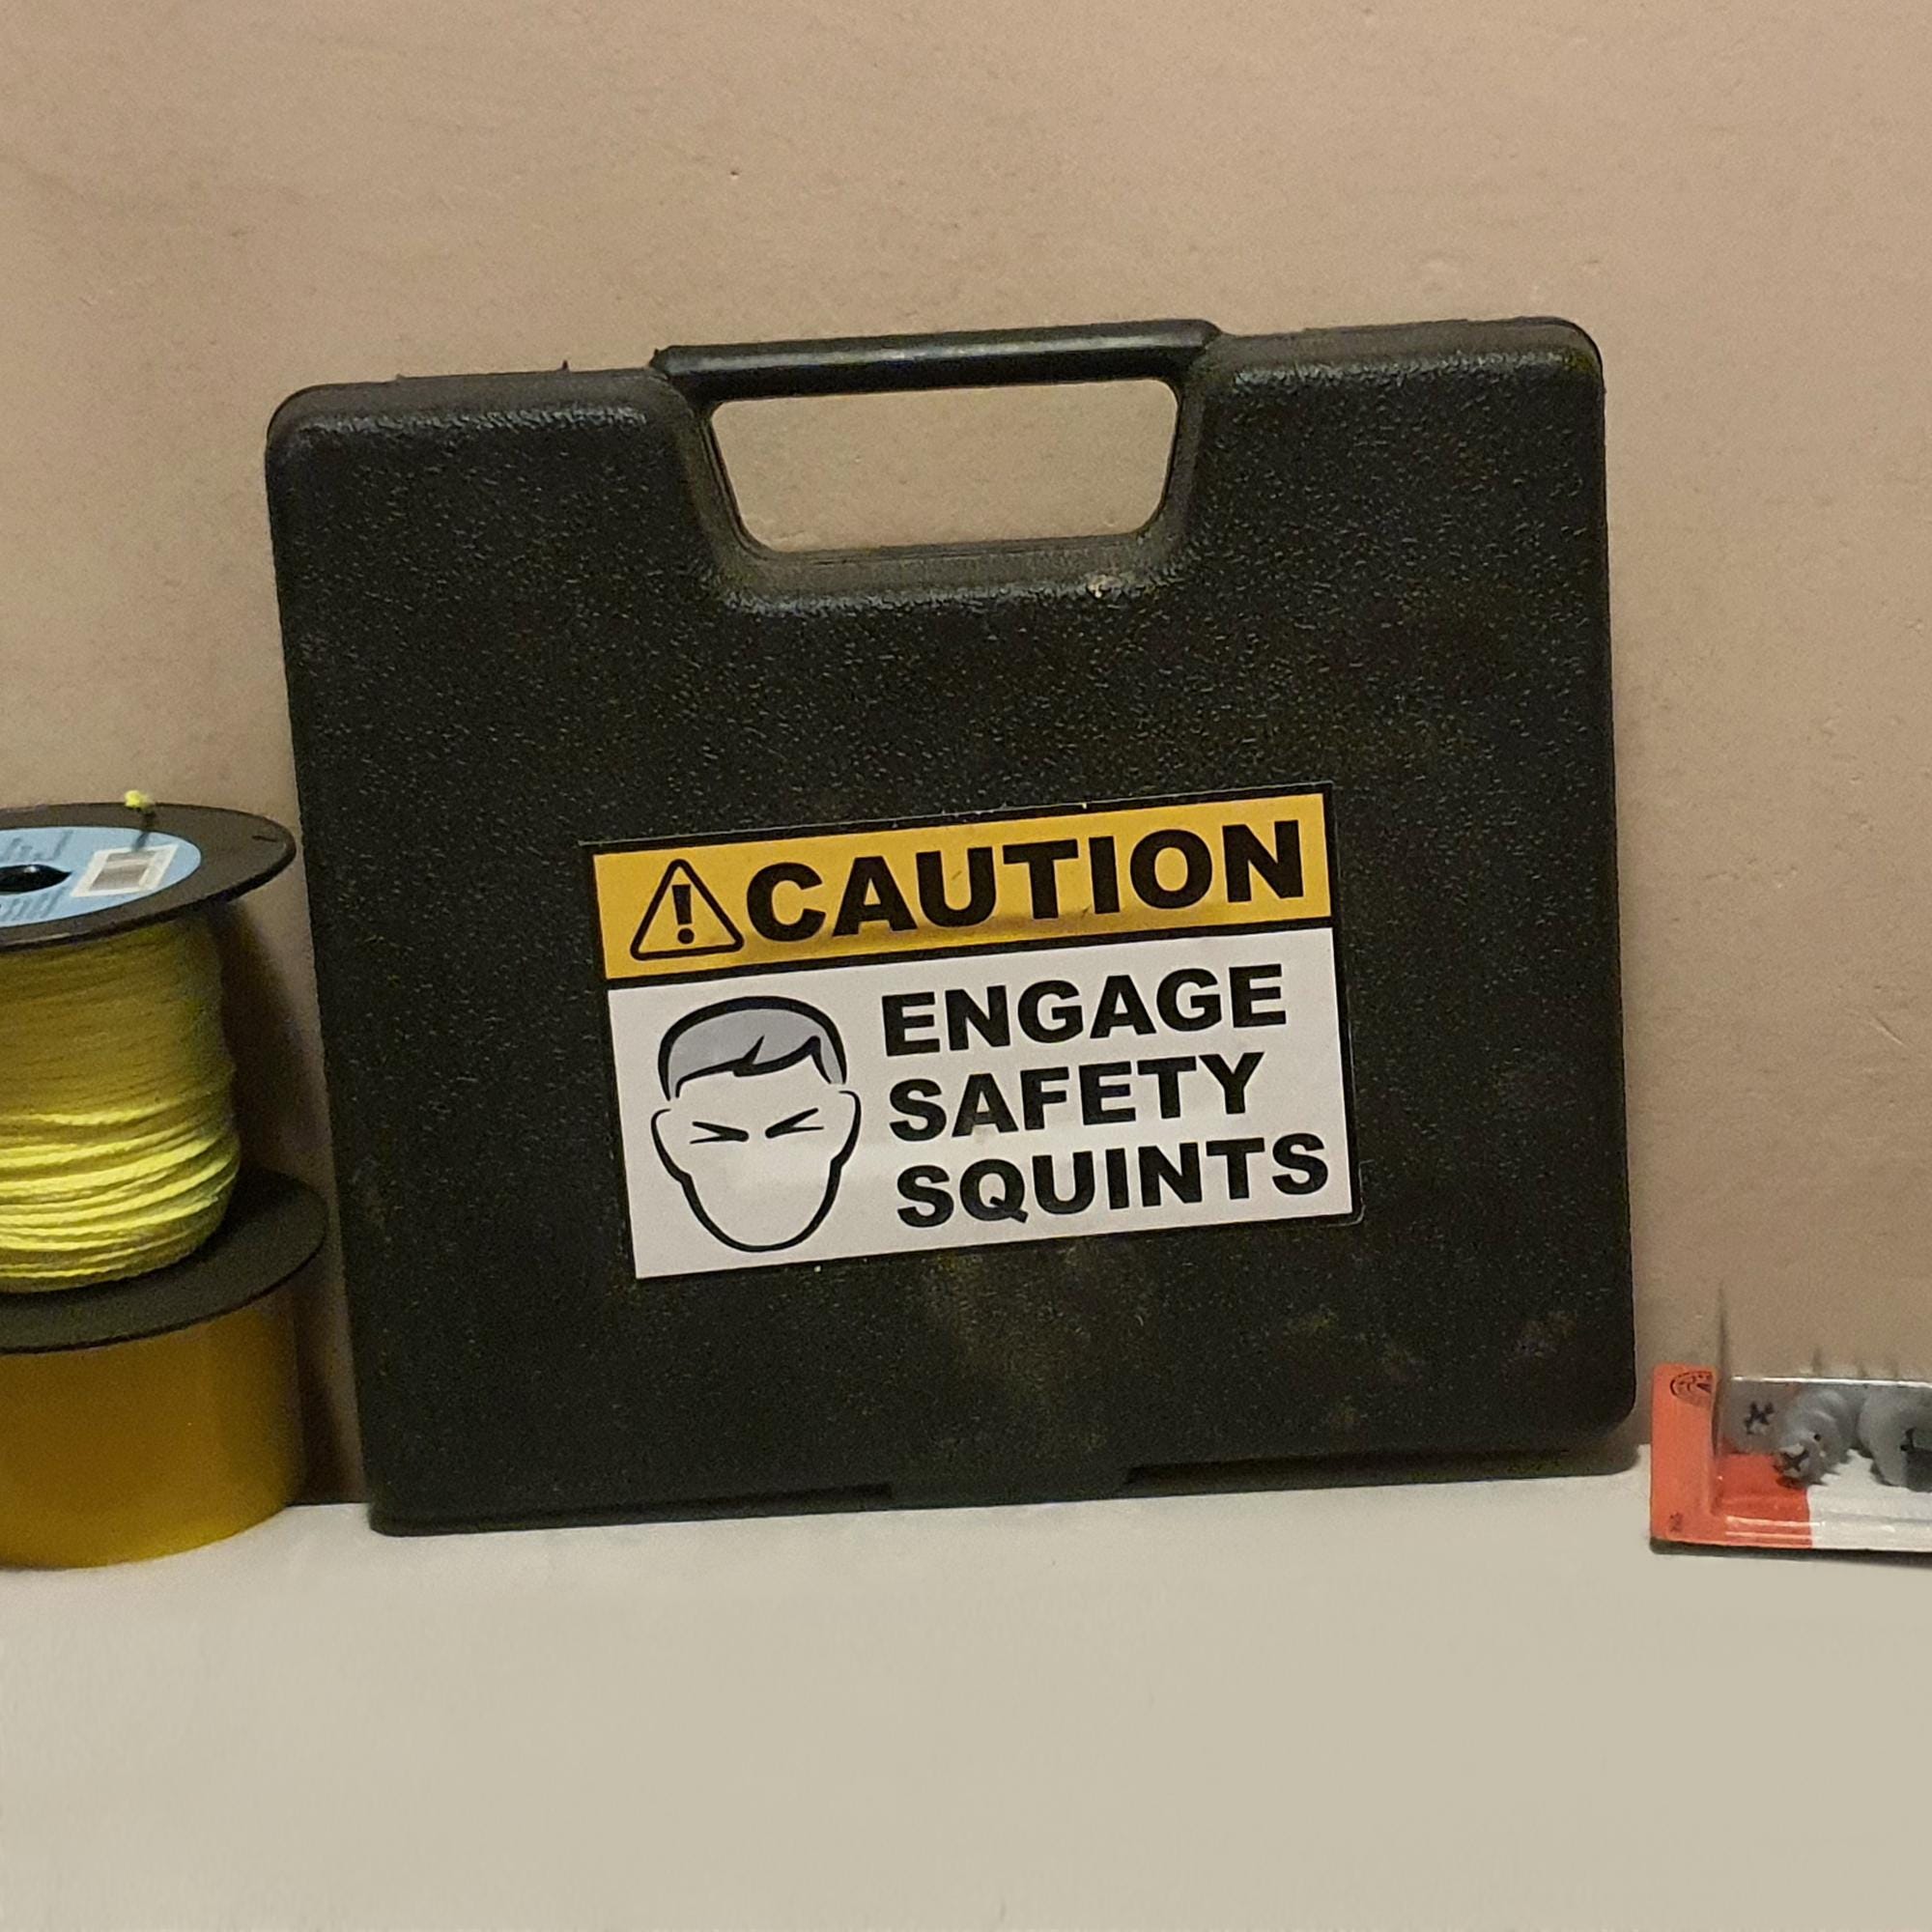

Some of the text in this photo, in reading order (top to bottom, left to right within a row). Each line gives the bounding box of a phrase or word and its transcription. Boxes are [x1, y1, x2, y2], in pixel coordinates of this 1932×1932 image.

[746, 819, 1304, 943] CAUTION
[881, 963, 1287, 1057] ENGAGE
[889, 1051, 1264, 1142] SAFETY
[896, 1132, 1329, 1229] SQUINTS
